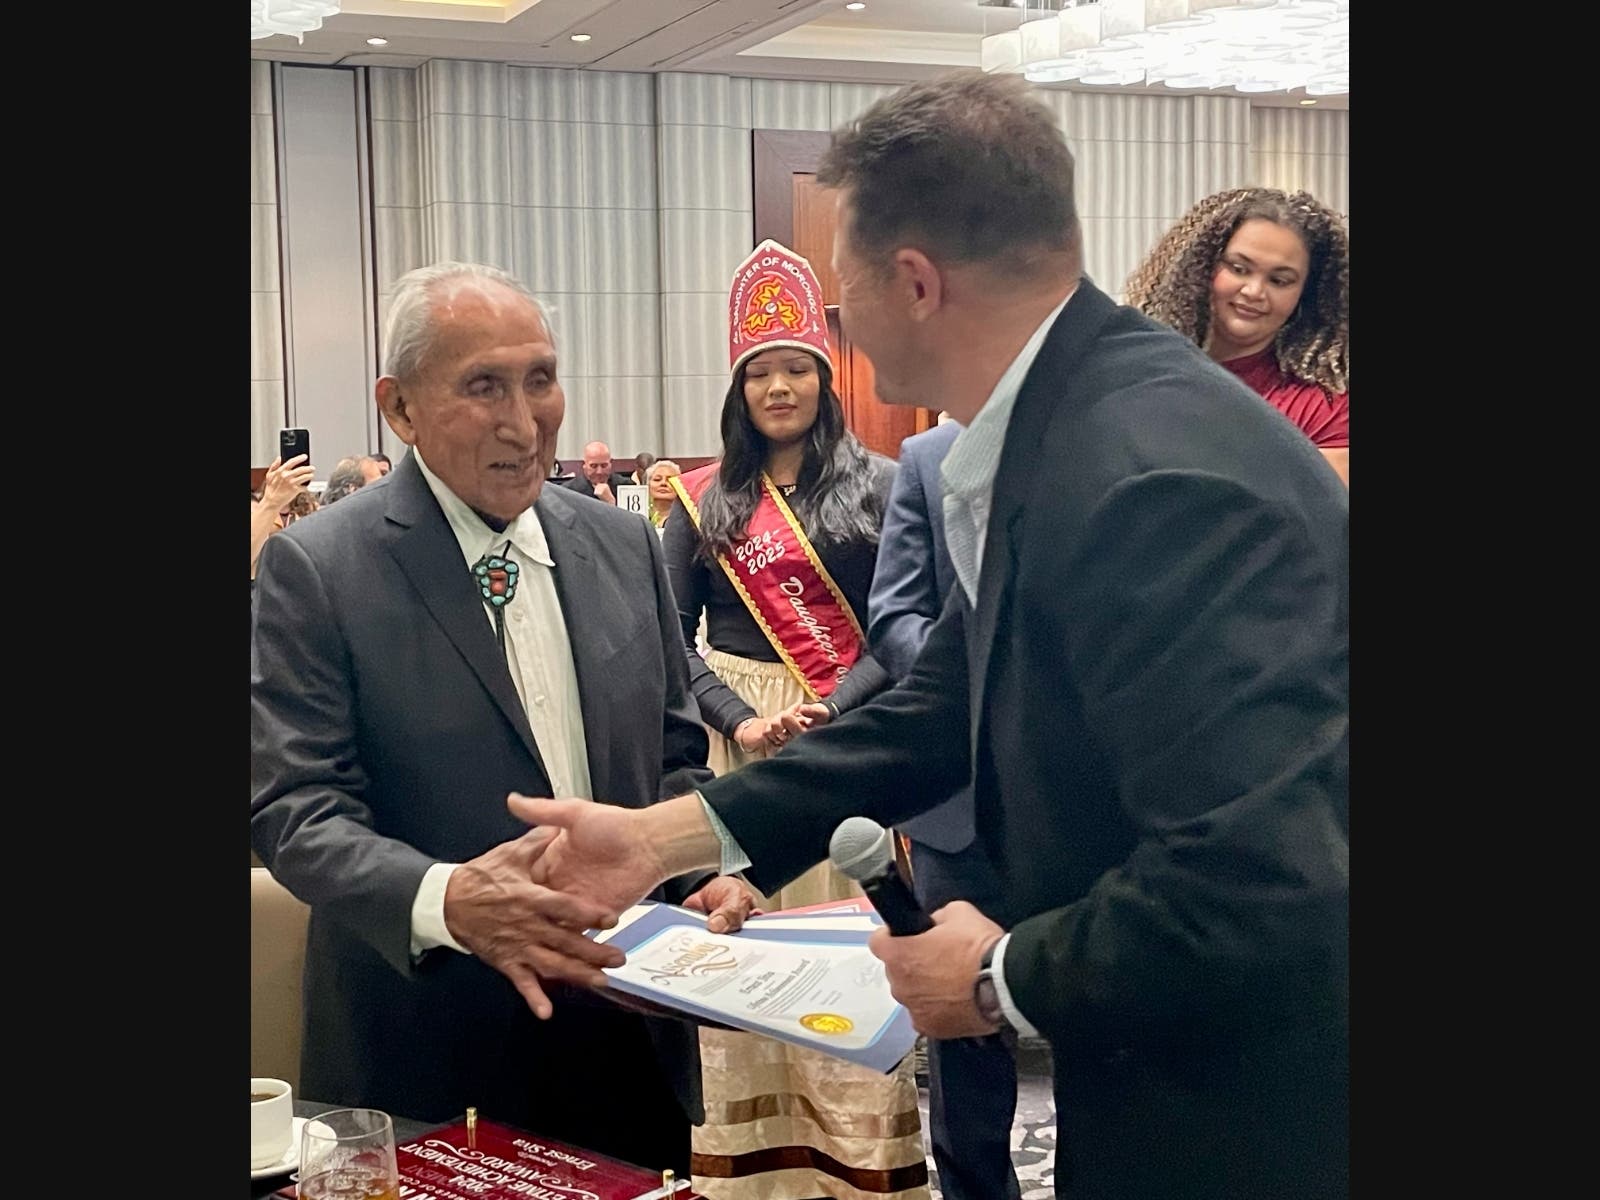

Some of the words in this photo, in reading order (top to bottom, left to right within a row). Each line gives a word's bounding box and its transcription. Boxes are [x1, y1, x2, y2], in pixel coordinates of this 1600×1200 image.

[733, 262, 761, 325] DAUGHTER
[762, 257, 780, 266] OF
[781, 260, 818, 315] MORONGO
[626, 495, 640, 511] 18
[747, 541, 785, 575] 2025
[779, 576, 839, 663] Daughter
[512, 1138, 546, 1154] Siva
[399, 1143, 517, 1184] ACHIEVEMENT
[480, 1156, 547, 1181] AWARD
[544, 1150, 597, 1171] Ernest
[449, 1175, 494, 1193] 2024
